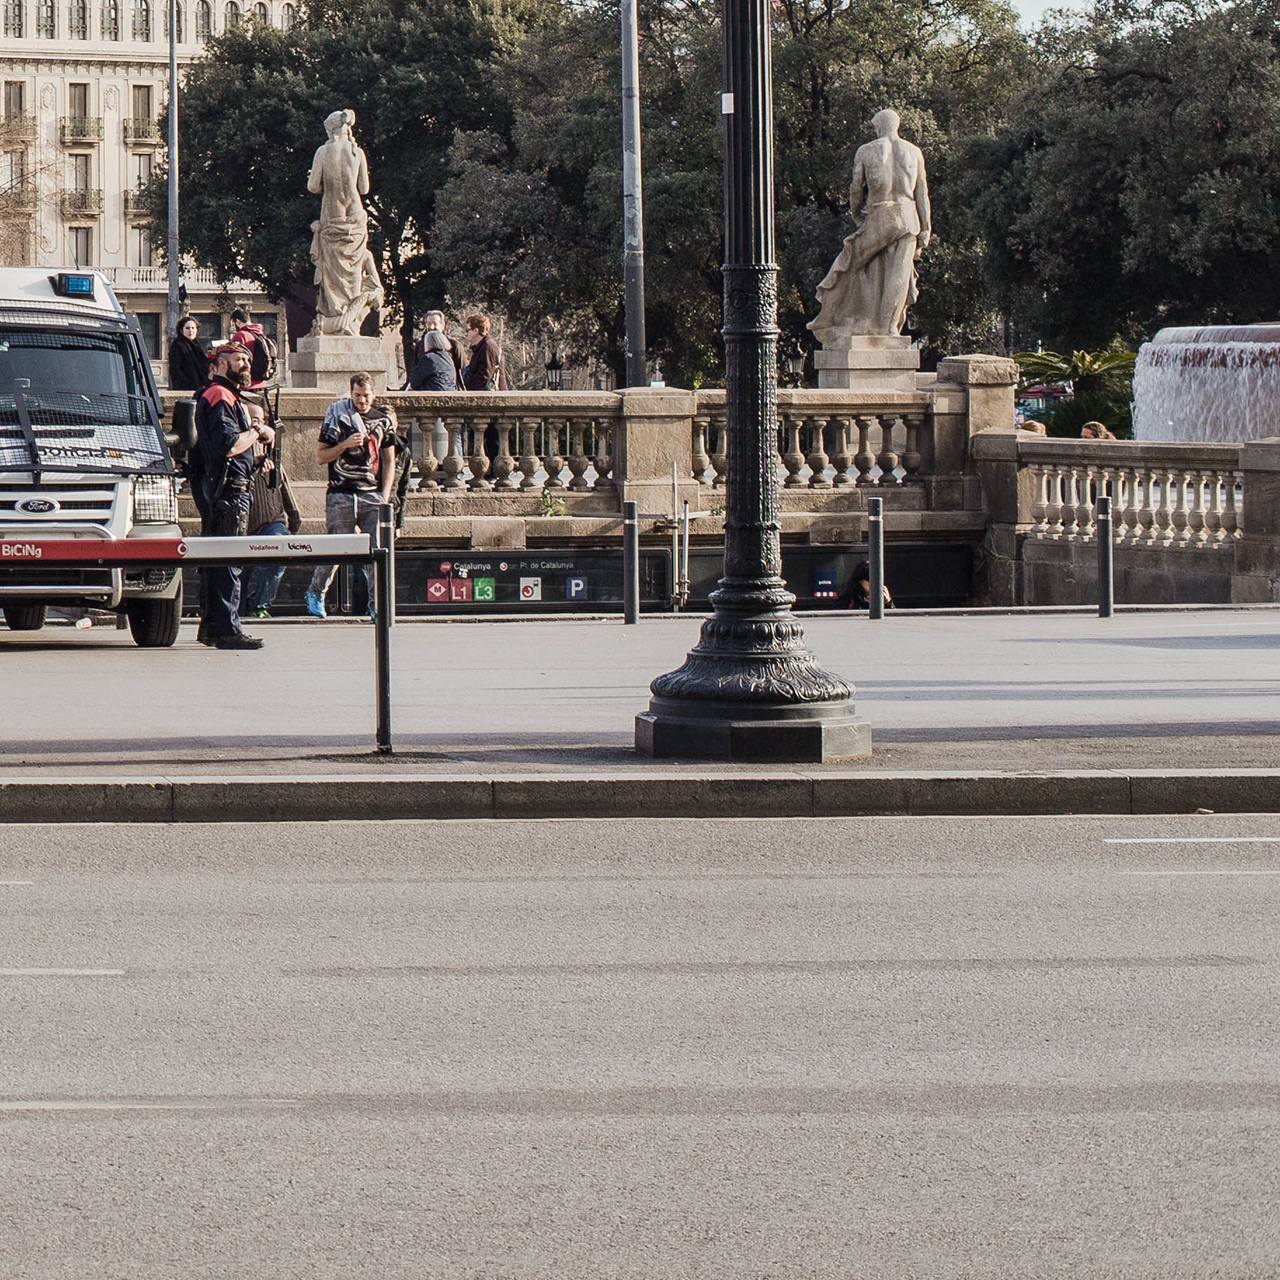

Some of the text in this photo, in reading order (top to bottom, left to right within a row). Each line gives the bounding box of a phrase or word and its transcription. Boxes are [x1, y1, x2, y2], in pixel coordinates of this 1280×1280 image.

[28, 500, 49, 510] Ford
[453, 562, 491, 571] Catalunya
[540, 561, 574, 570] Catalunya
[452, 586, 467, 600] L1
[475, 585, 493, 600] L3
[571, 579, 584, 597] P
